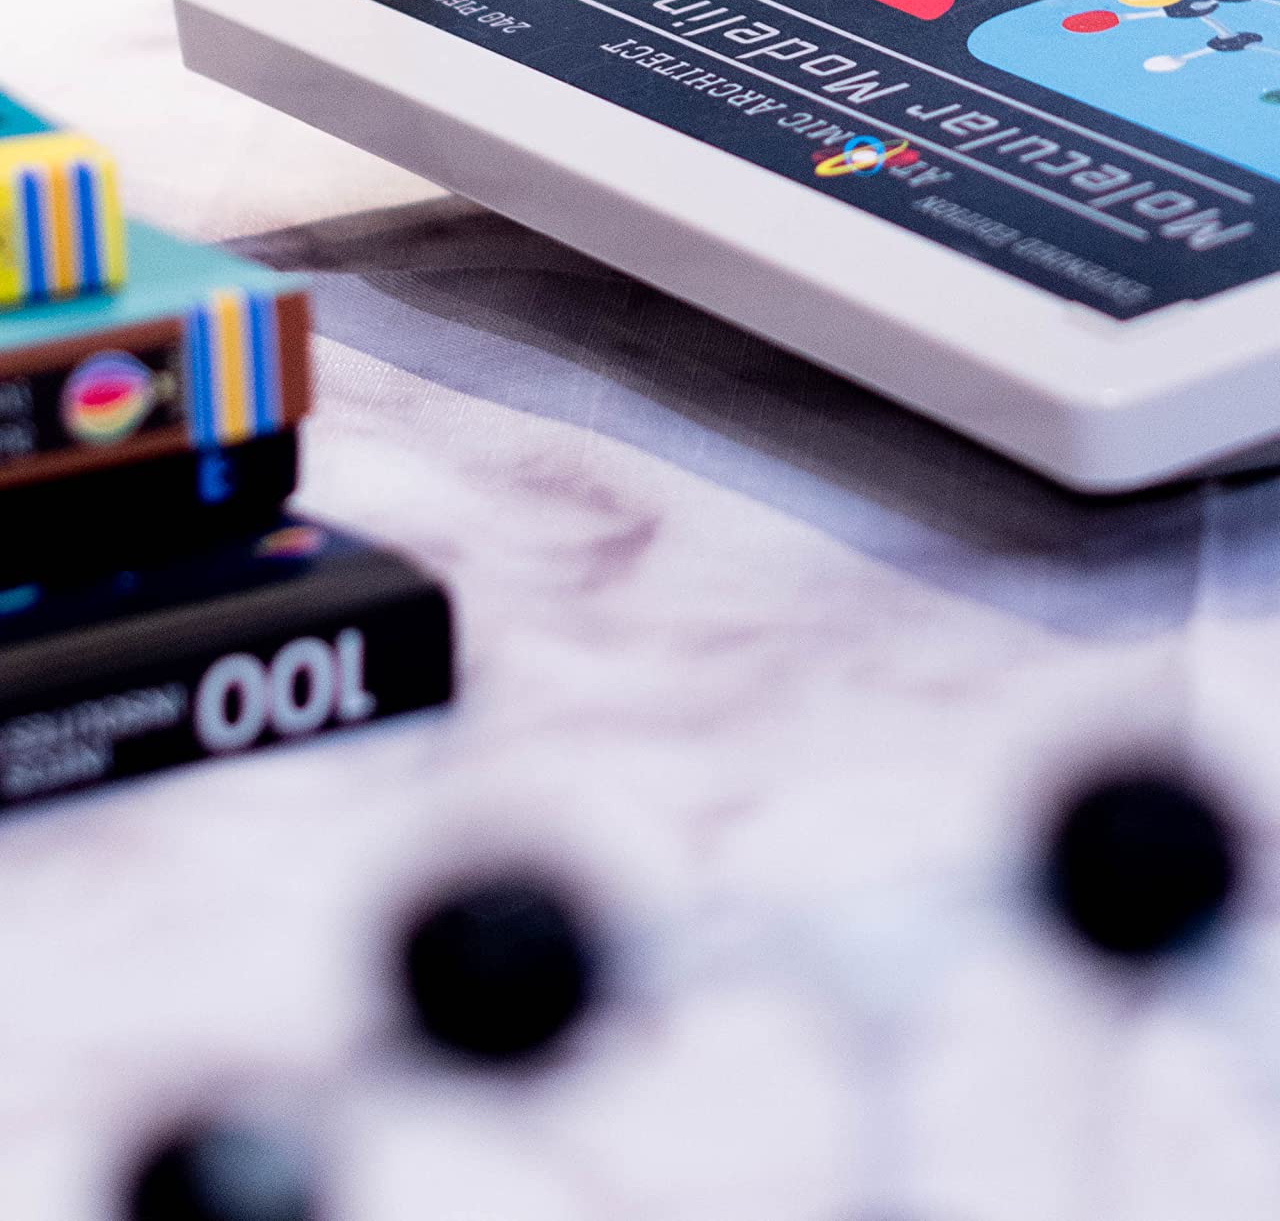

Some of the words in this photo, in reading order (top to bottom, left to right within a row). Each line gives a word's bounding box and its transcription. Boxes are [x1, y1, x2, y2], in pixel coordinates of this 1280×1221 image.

[600, 39, 787, 115] ARCHITECT
[906, 104, 1252, 249] Molecular
[916, 196, 1017, 243] EDITION
[193, 628, 376, 754] 100
